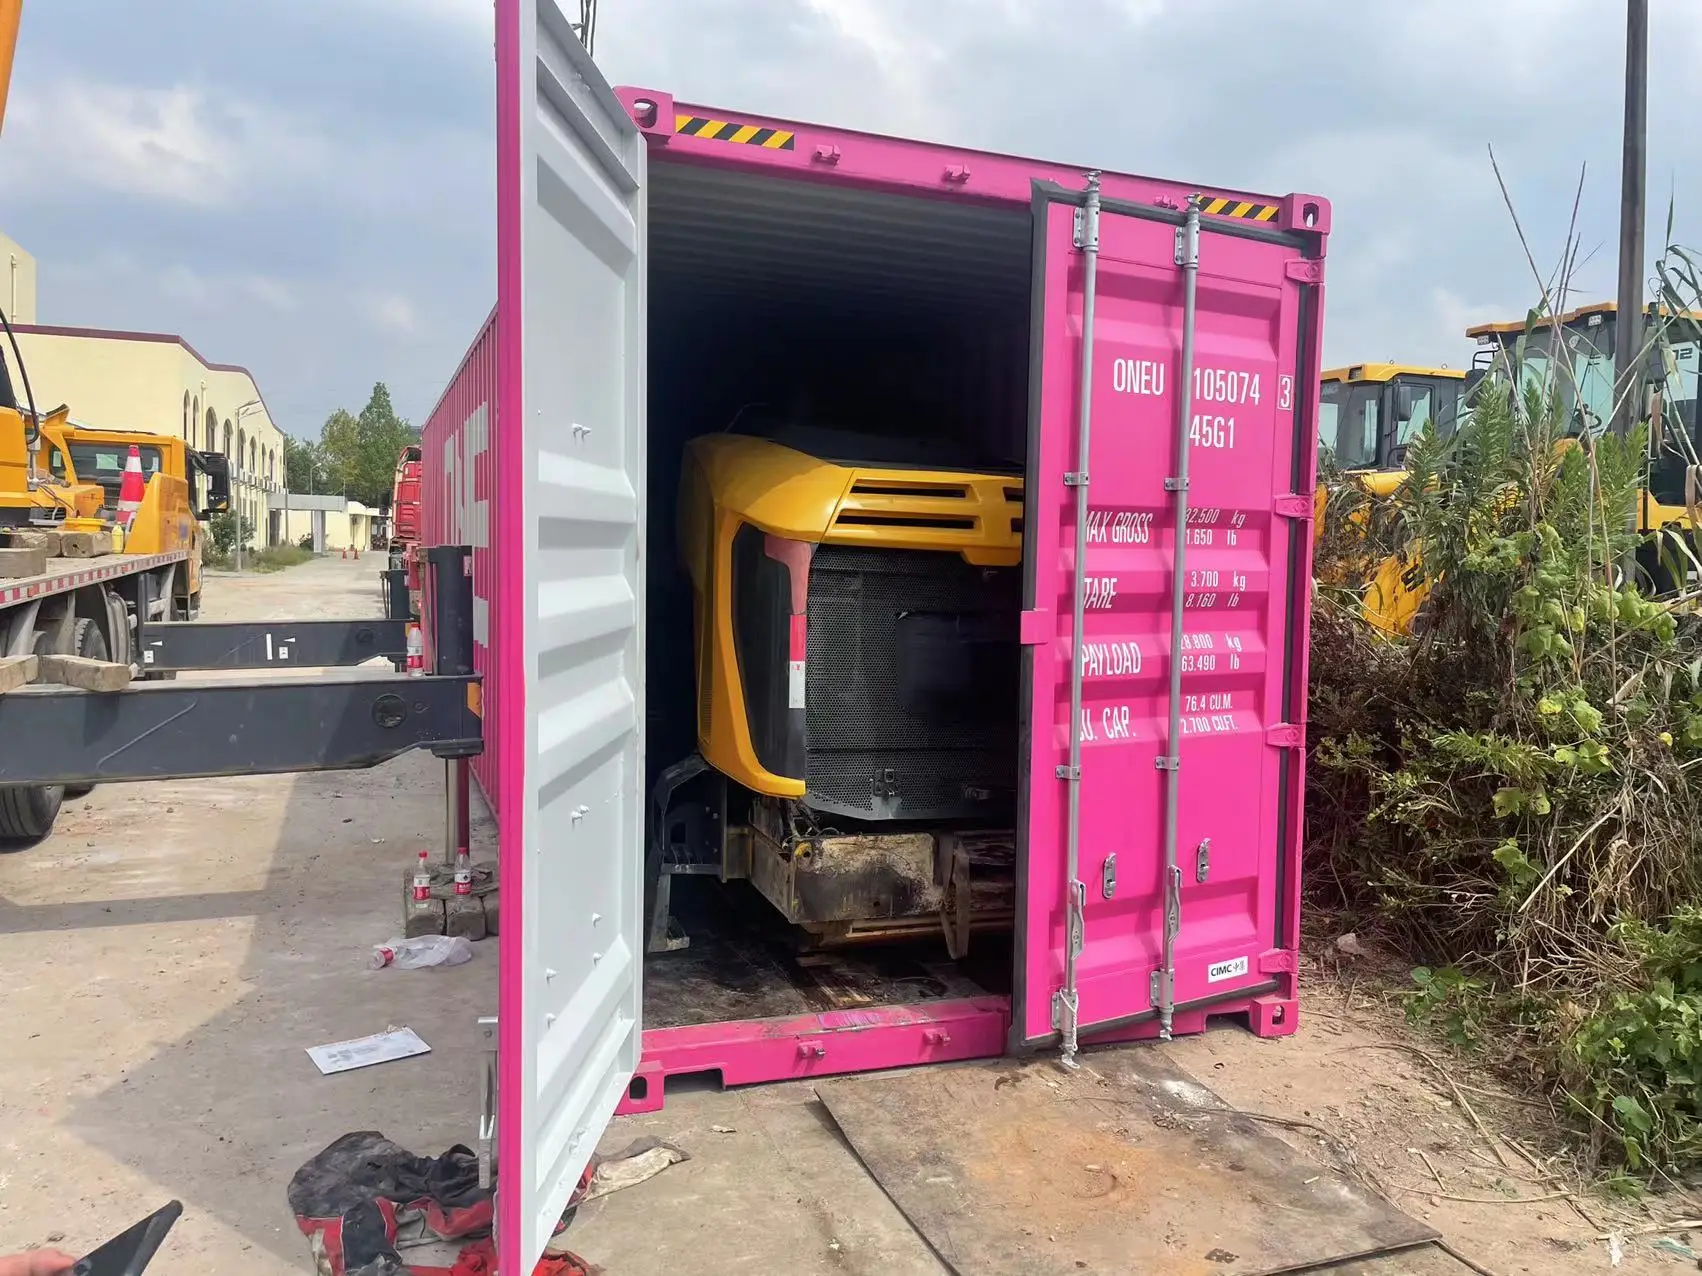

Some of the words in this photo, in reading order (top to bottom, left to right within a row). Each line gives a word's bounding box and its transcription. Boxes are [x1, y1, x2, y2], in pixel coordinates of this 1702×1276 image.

[1113, 358, 1165, 396] ONEU
[1193, 367, 1260, 405] 105074
[1280, 376, 1291, 409] 3
[1189, 414, 1235, 449] 45G1
[1112, 512, 1153, 544] GROSS
[1231, 510, 1246, 528] kg
[1186, 528, 1213, 545] 1.650
[1227, 529, 1237, 546] lb
[1191, 570, 1219, 588] 3.700
[1233, 571, 1246, 591] kg
[1084, 577, 1118, 609] TARE
[1185, 593, 1216, 608] 8.160
[1227, 593, 1240, 607] lb
[1225, 633, 1242, 652] kg
[1082, 642, 1142, 677] PAYLOAD
[1181, 654, 1216, 672] 63.490
[1230, 653, 1240, 670] lb
[1185, 694, 1206, 713] 76.4
[1080, 708, 1098, 742] U.
[1103, 705, 1137, 740] CAP.
[1210, 964, 1233, 977] CIMC
